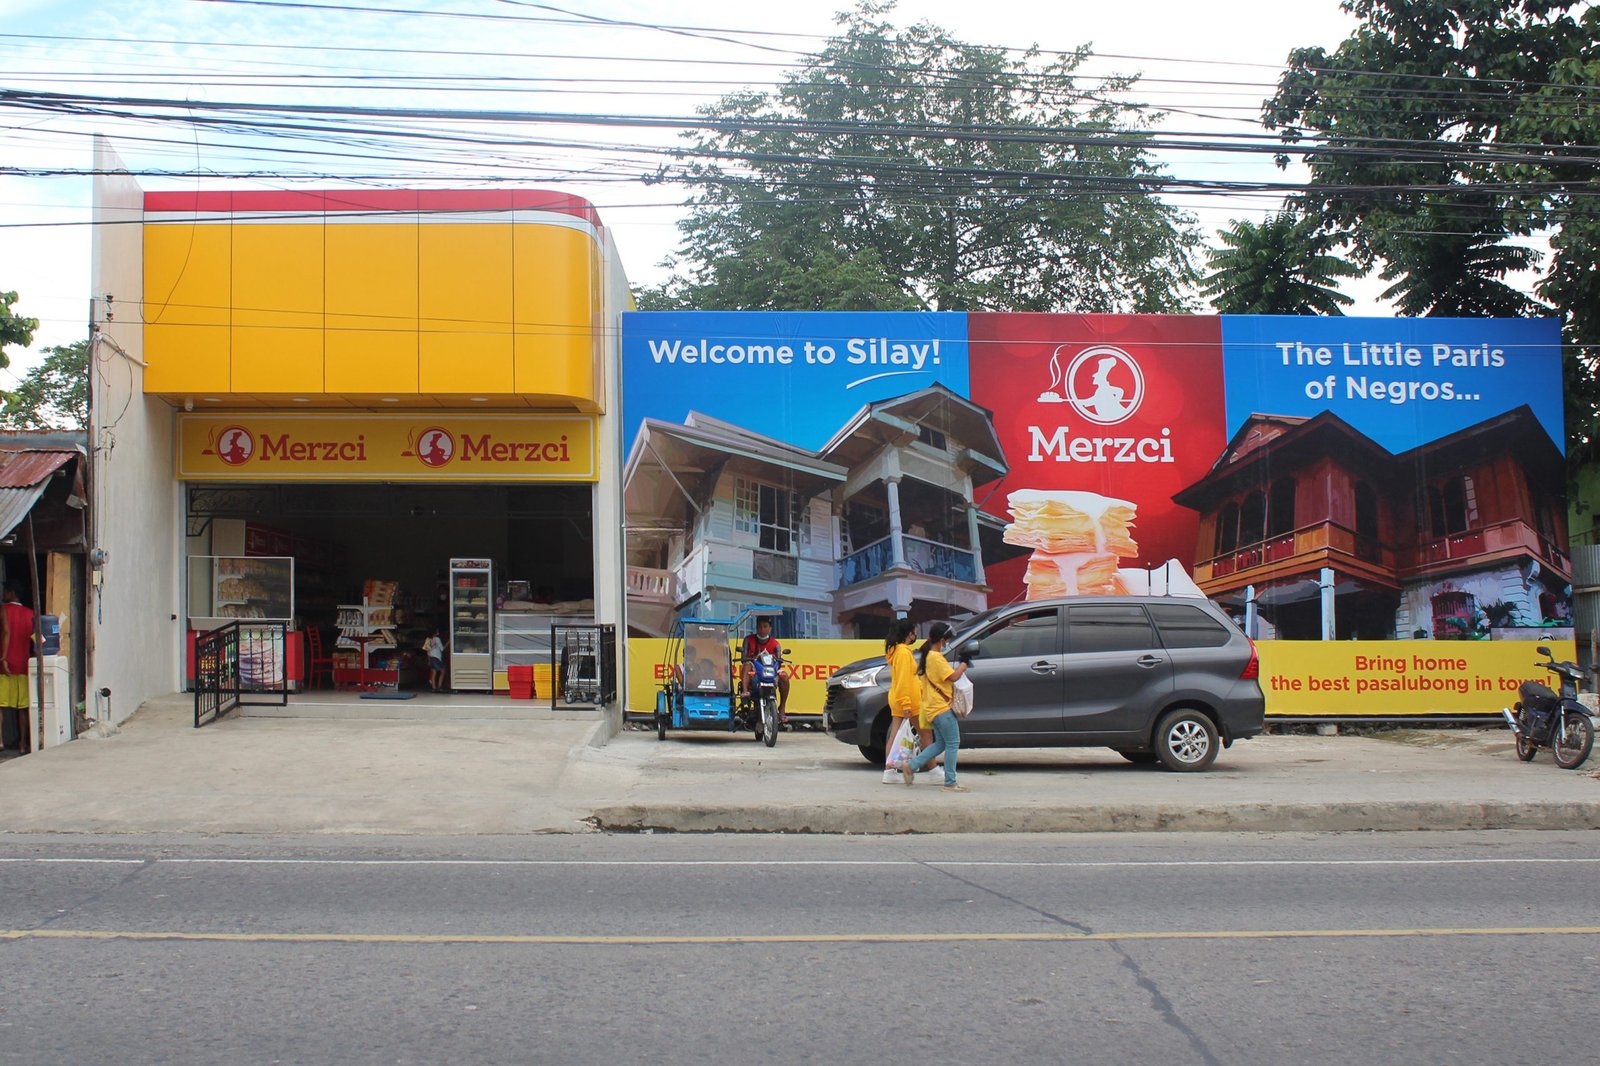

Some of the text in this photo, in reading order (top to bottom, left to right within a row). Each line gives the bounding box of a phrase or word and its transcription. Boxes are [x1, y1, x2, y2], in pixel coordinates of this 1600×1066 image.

[648, 338, 940, 370] Welcome to Silay!
[1275, 341, 1505, 367] The Little Paris
[1305, 375, 1480, 404] of Negros...
[259, 434, 366, 461] Merzci
[460, 434, 570, 462] Merzci
[1028, 426, 1174, 463] Merzci
[1355, 655, 1467, 674] Bring home
[1270, 675, 1552, 694] the best pasalubong in to!
